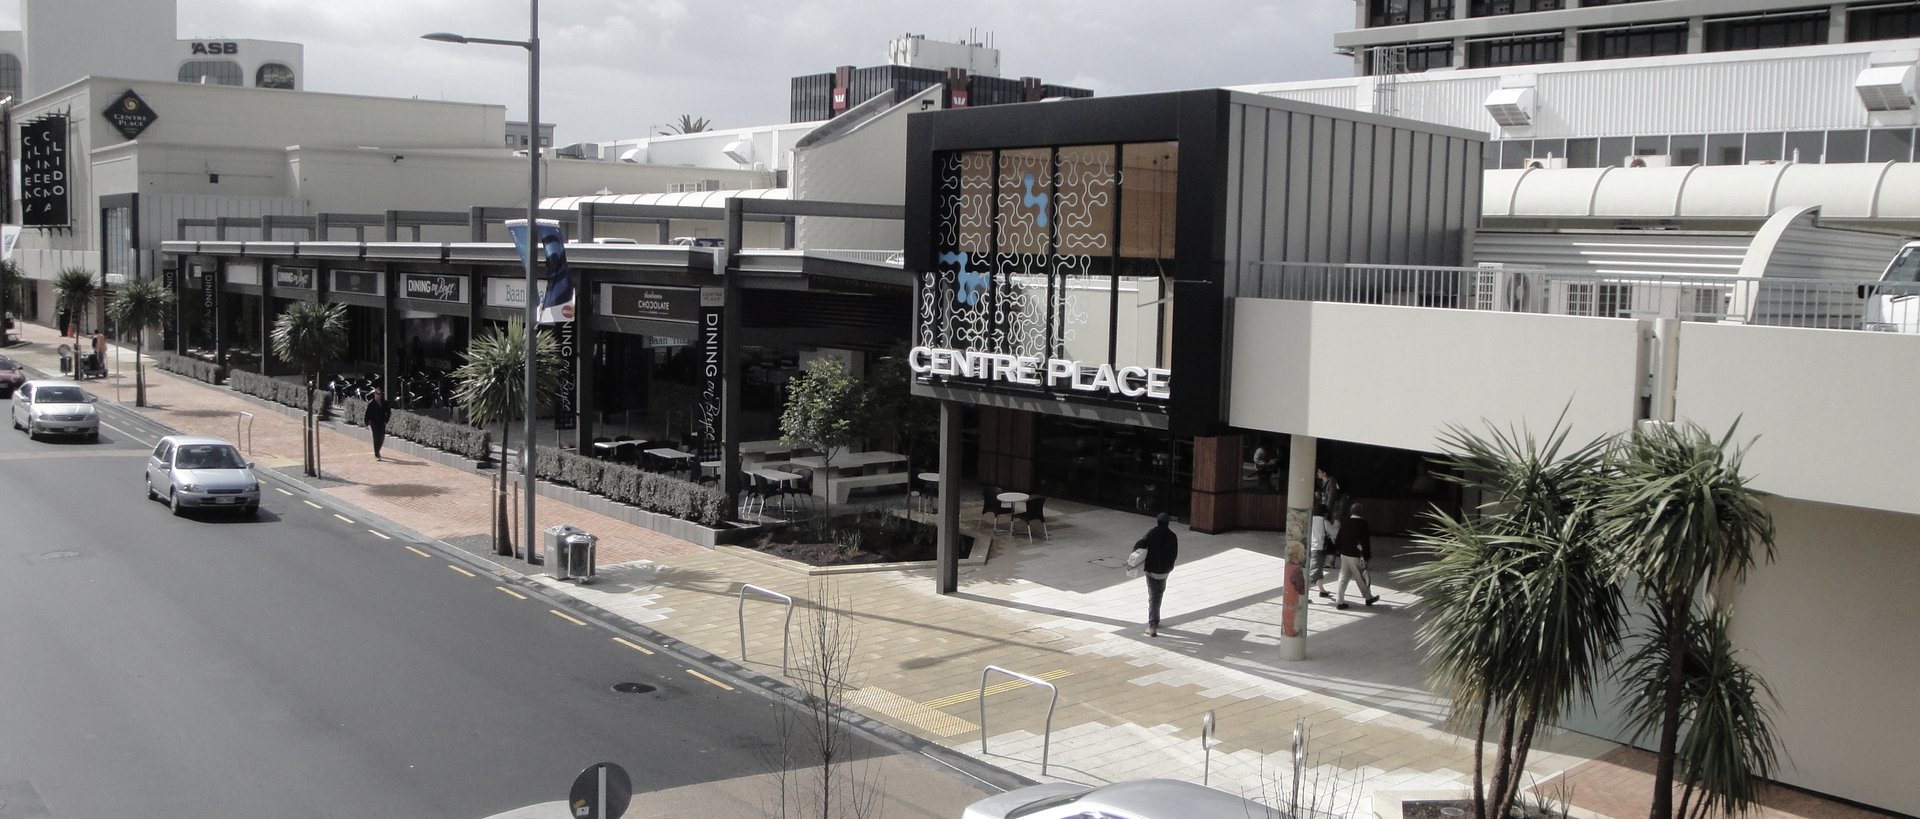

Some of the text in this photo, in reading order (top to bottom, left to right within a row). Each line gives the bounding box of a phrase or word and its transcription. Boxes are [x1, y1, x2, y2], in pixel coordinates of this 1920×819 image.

[191, 42, 238, 55] ASB
[114, 113, 147, 121] CENTRE
[53, 141, 65, 196] LIDO
[204, 274, 213, 308] DINING
[408, 279, 431, 293] DINING
[506, 284, 525, 303] Baan
[637, 300, 670, 311] CHOCOLATE
[561, 321, 573, 357] NING
[699, 313, 721, 441] DINING on Bryce
[909, 346, 1171, 399] CENTRE PLACE
